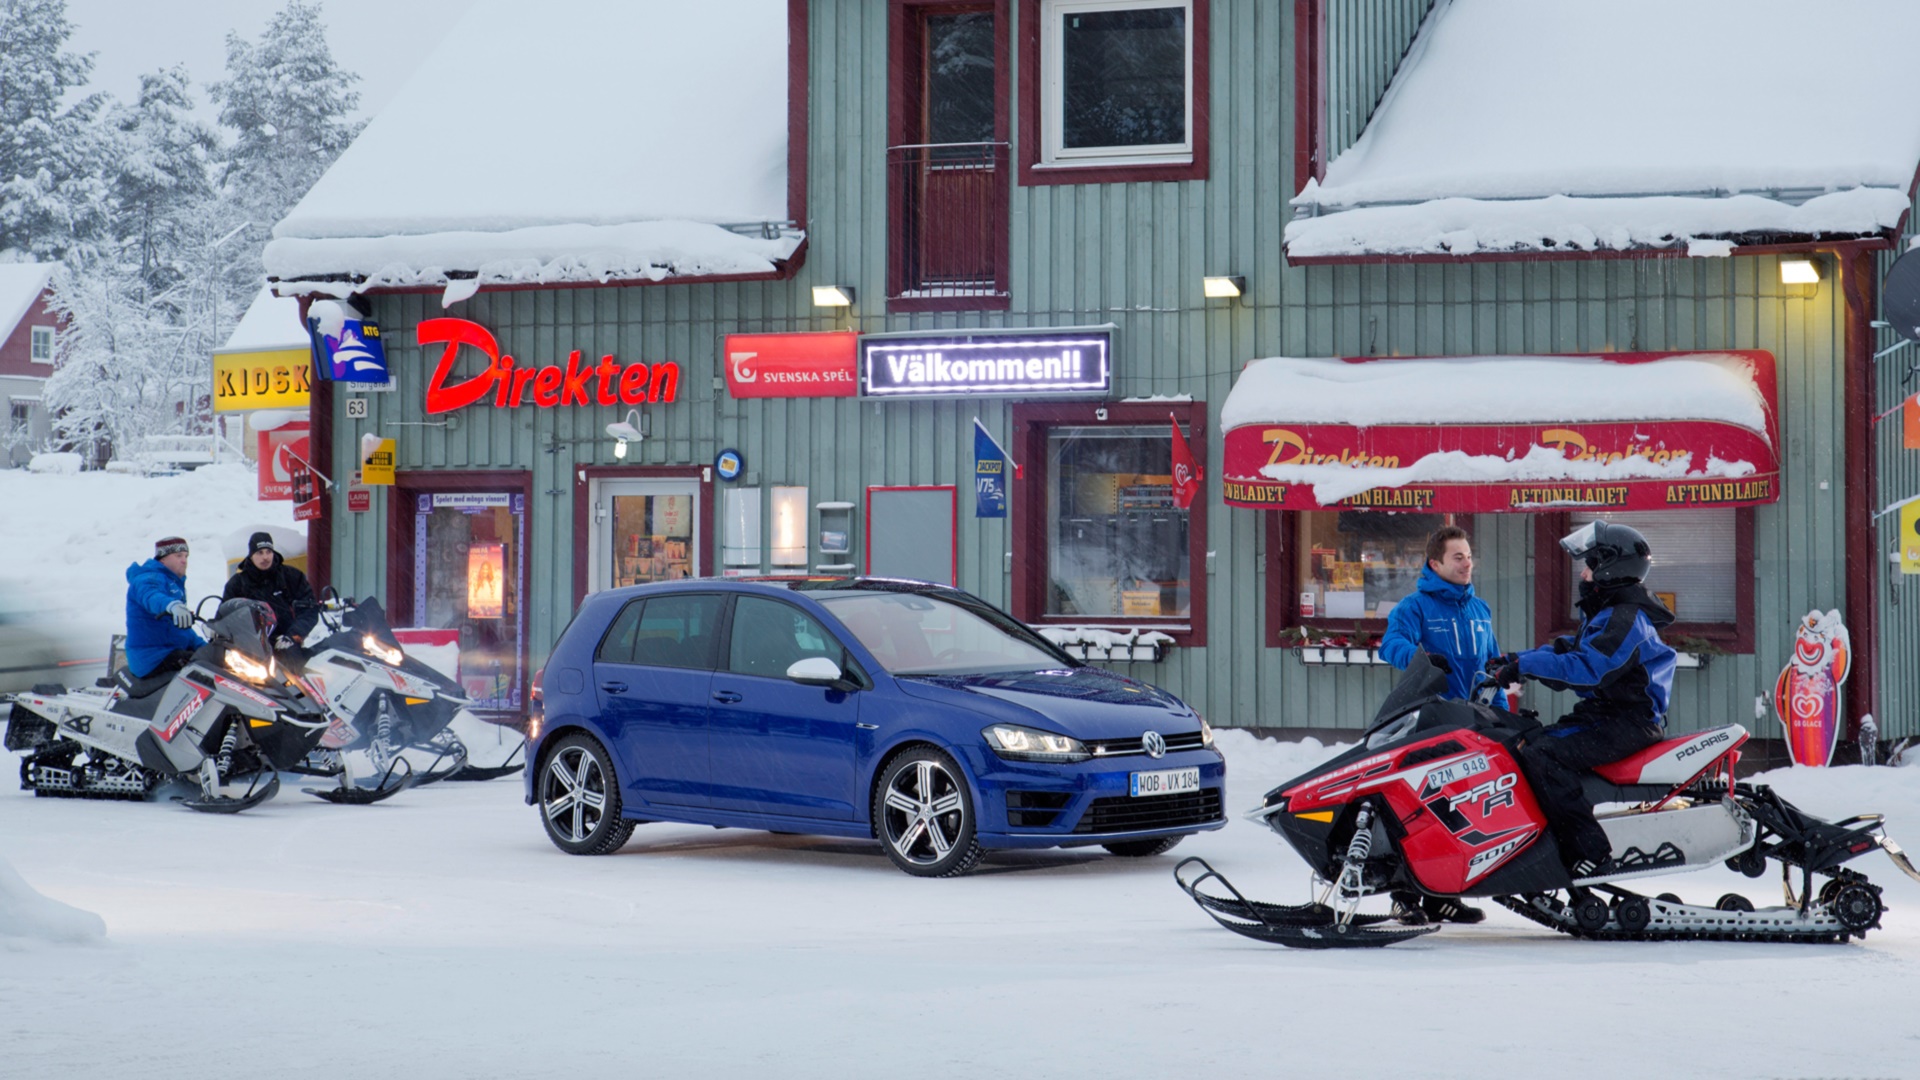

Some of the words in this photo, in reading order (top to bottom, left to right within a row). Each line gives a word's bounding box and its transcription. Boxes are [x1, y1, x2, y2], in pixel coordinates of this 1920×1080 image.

[363, 325, 380, 337] ATG
[416, 317, 680, 414] Direkten
[886, 349, 1081, 384] Välkommen!!
[217, 364, 310, 397] KIOSK
[763, 371, 820, 383] SVENSKA
[349, 400, 365, 415] 63
[978, 461, 1001, 472] JACKPOT
[976, 477, 995, 493] V75
[1224, 482, 1286, 502] NBLADET
[1510, 487, 1628, 505] AFTONBLADET
[1666, 480, 1769, 502] AFTONBLADET
[349, 493, 369, 501] LARM
[453, 495, 465, 503] med
[220, 679, 271, 706] POLARIS
[1675, 732, 1730, 761] POLARIS
[1139, 774, 1160, 792] WOB
[1167, 772, 1180, 790] VX
[1181, 770, 1199, 789] 184
[1304, 753, 1391, 789] POLARIS
[1430, 768, 1455, 786] PZM
[1462, 757, 1487, 776] 948
[1449, 772, 1518, 813] PRO
[1482, 789, 1515, 818] R
[1468, 841, 1516, 868] 600
